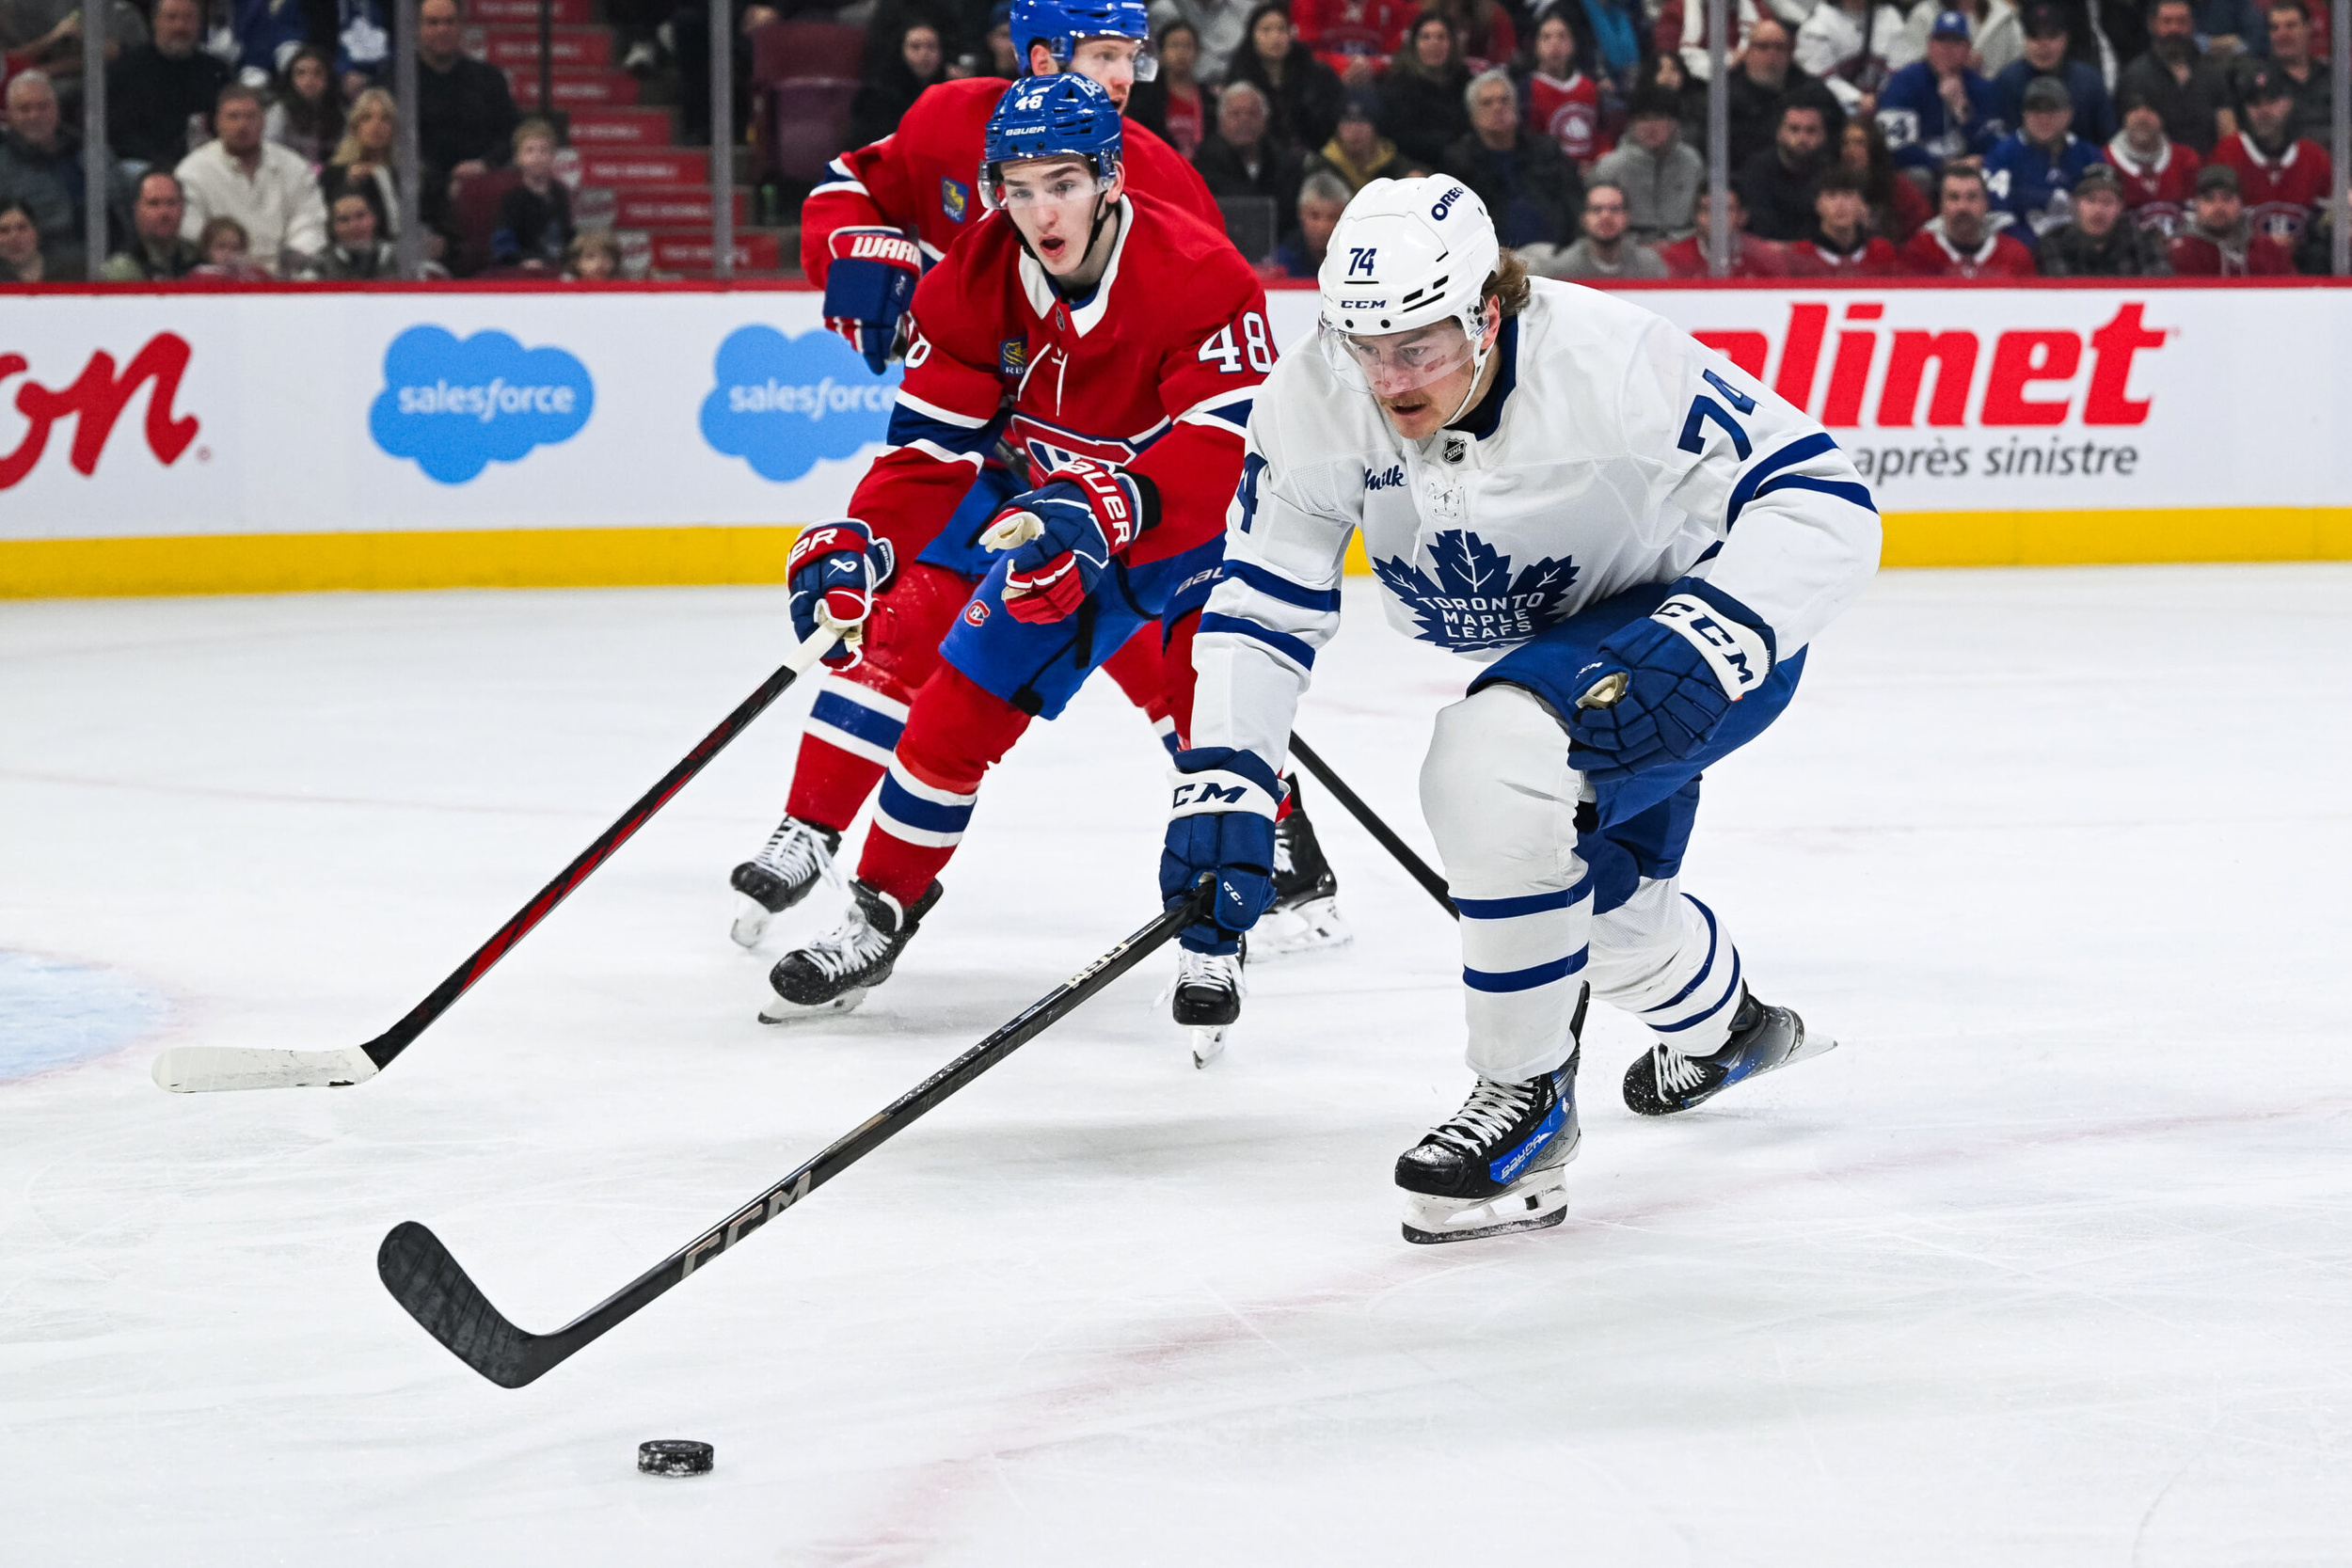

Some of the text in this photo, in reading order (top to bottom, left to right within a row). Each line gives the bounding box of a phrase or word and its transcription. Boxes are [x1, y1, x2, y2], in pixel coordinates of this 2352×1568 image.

[1015, 95, 1043, 110] 48
[1348, 247, 1377, 276] 74
[1341, 299, 1387, 309] CCM
[1199, 311, 1272, 373] 48
[1005, 366, 1028, 374] RB
[397, 377, 576, 422] salesforce
[1446, 445, 1464, 459] NHL
[1855, 436, 2138, 485] après sinistre
[1416, 592, 1546, 611] TORONTO
[1441, 608, 1530, 626] MAPLE
[1445, 621, 1533, 639] LEAFS
[1654, 602, 1754, 685] CCM
[681, 1170, 811, 1279] CCM
